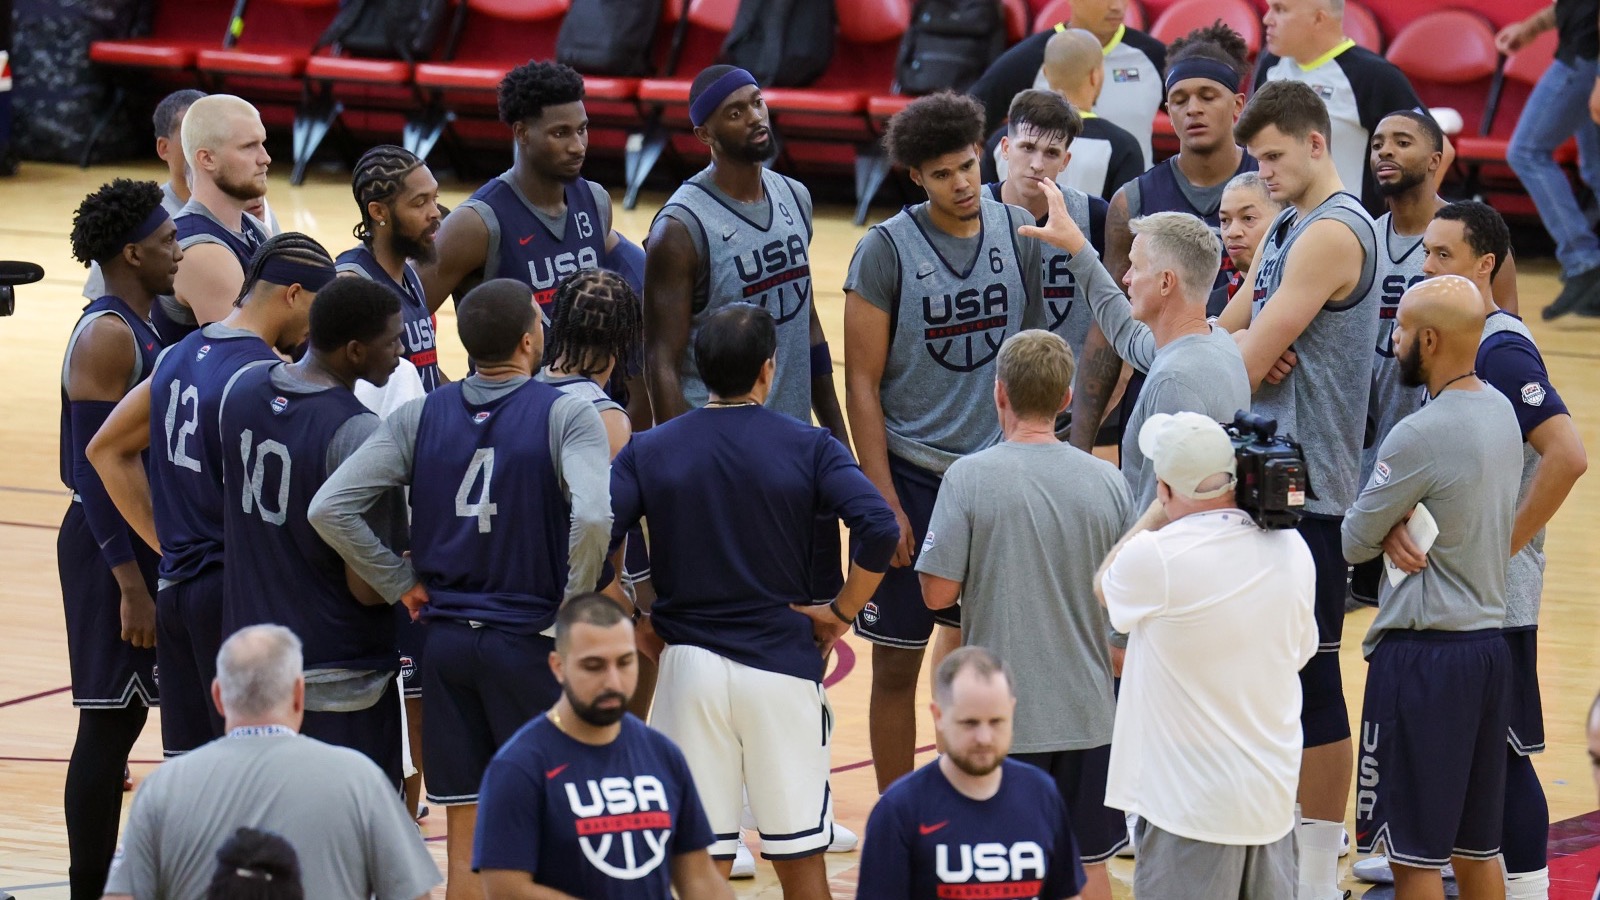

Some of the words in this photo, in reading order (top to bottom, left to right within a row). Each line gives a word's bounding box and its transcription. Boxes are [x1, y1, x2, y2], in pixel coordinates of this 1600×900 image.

[574, 211, 593, 239] 13
[779, 203, 793, 226] 9
[528, 246, 599, 289] USA
[734, 234, 807, 283] USA
[988, 247, 1004, 274] 6
[922, 282, 1007, 325] USA
[928, 318, 1007, 338] BASKETBALL
[165, 378, 201, 472] 12
[240, 428, 291, 526] 10
[455, 447, 497, 533] 4
[1357, 721, 1379, 820] USA
[564, 775, 669, 818] USA
[583, 816, 667, 830] BASKETBALL
[936, 841, 1045, 883] USA
[943, 884, 1035, 897] BASKETBALL
